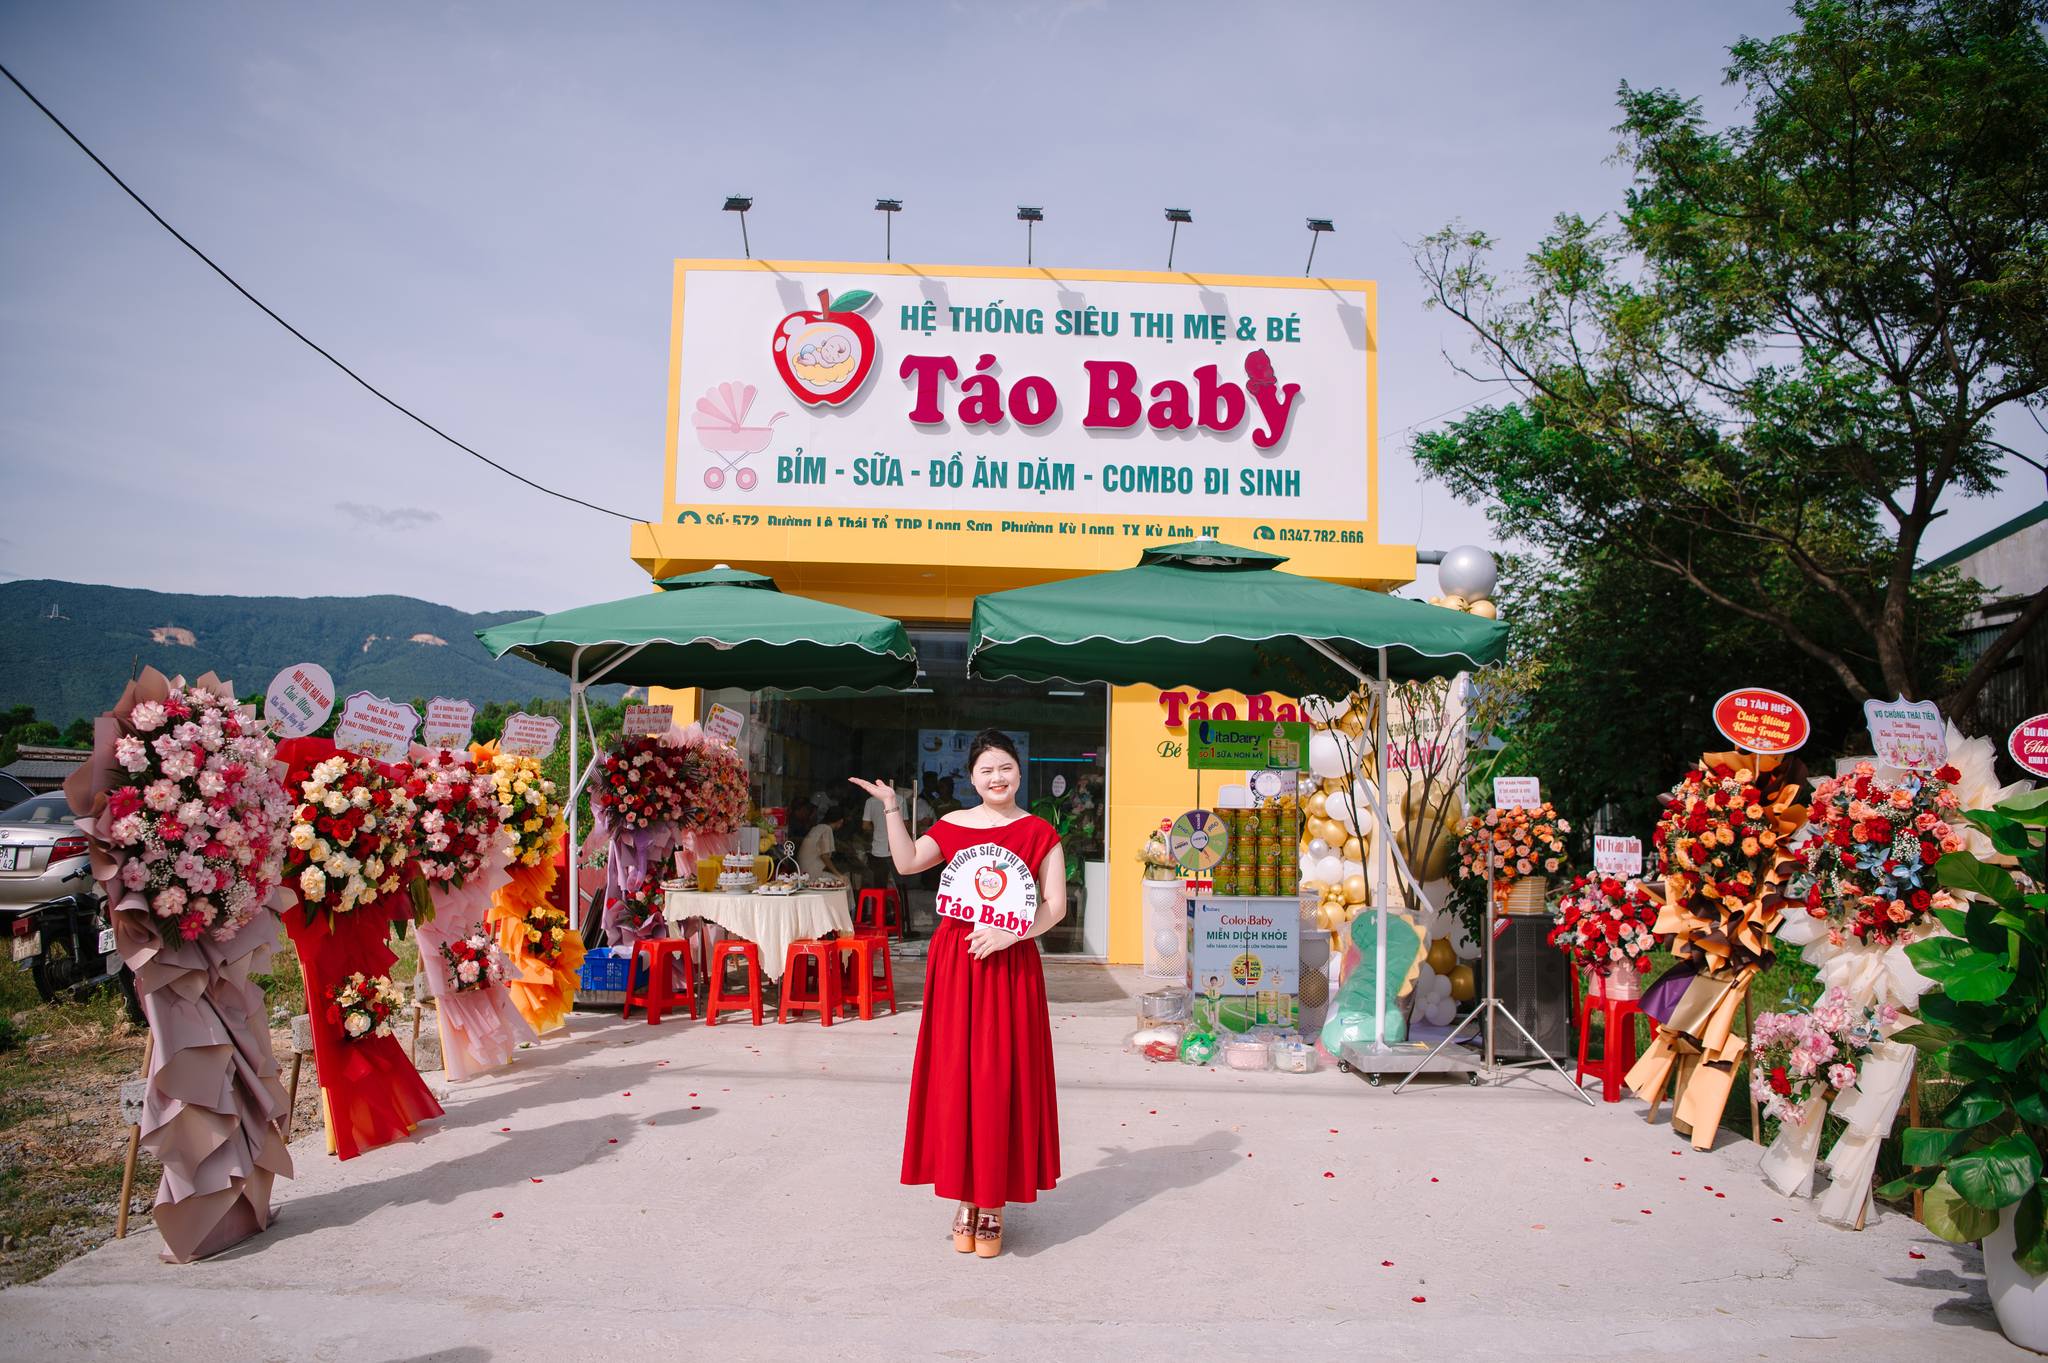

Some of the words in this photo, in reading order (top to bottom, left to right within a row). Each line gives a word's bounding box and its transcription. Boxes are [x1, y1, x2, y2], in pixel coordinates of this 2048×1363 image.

[901, 300, 937, 336] HỆ
[949, 299, 1044, 335] THỐNG
[1055, 305, 1119, 337] SIÊU
[1130, 312, 1174, 343] THỊ
[1184, 314, 1227, 345] MẸ
[1236, 316, 1257, 341] &
[1267, 313, 1301, 343] BÉ
[899, 353, 1058, 427] Táo
[1082, 357, 1301, 449] Baby
[777, 447, 826, 485] BỈM
[853, 452, 904, 488] SỮA
[929, 451, 964, 488] ĐỒ
[972, 456, 1008, 489] ĂN
[1018, 457, 1075, 495] DẶM
[1102, 464, 1193, 495] COMBO
[1204, 467, 1229, 496] ĐI
[1239, 468, 1300, 497] SINH
[1280, 528, 1364, 544] 0347.782.666
[1159, 691, 1237, 728] Táo
[1246, 693, 1310, 722] Ba
[1157, 741, 1182, 758] Bé
[941, 872, 955, 888] HỆ
[948, 847, 977, 873] THỐNG
[979, 844, 1003, 858] SIÊU
[1004, 850, 1020, 869] THỊ
[1017, 863, 1031, 881] MẸ
[937, 894, 975, 920] Táo
[979, 903, 1033, 937] Baby
